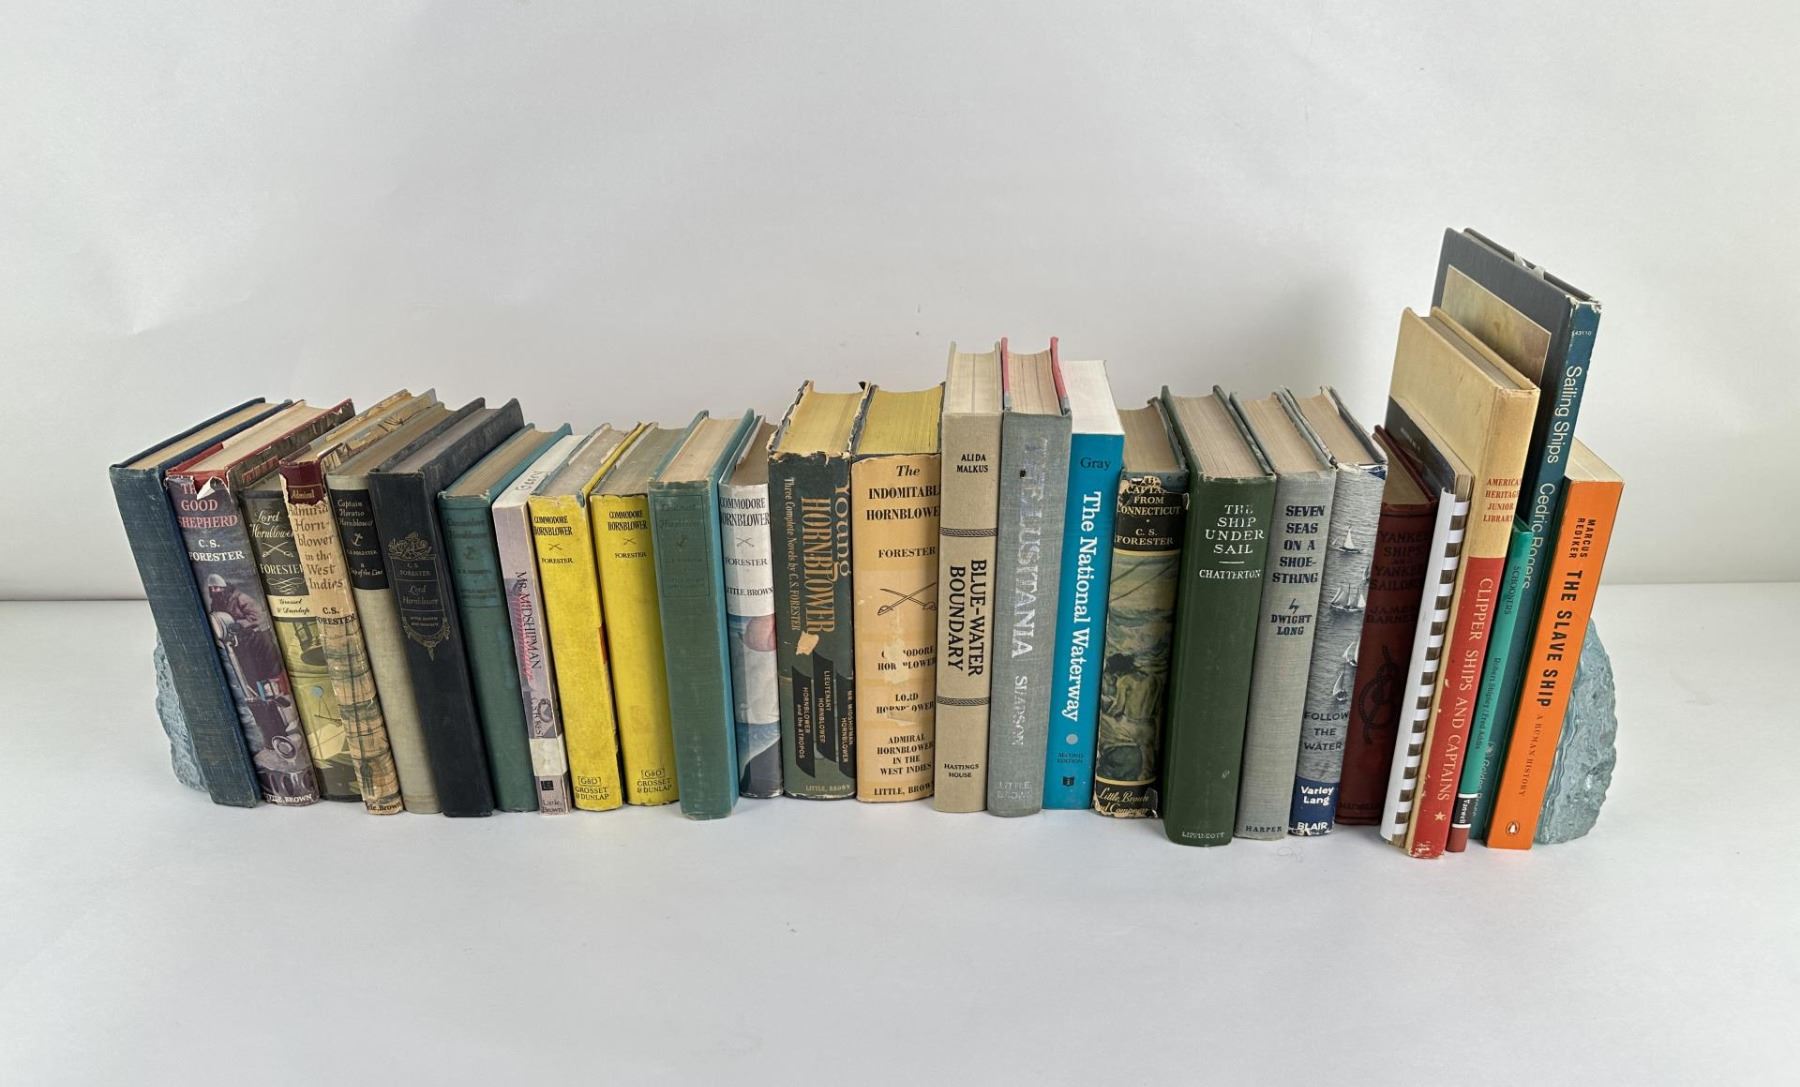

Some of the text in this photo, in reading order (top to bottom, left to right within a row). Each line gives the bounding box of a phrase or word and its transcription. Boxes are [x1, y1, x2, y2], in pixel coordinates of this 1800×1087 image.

[1554, 365, 1583, 418] Sailing
[1547, 421, 1571, 465] Ships
[960, 453, 987, 462] ALIDA
[1080, 457, 1112, 470] Gray
[895, 464, 921, 477] The
[956, 464, 989, 473] MALKUS
[783, 477, 795, 500] Three
[868, 485, 940, 499] INDOMITABL
[181, 499, 218, 512] GOOD
[720, 496, 766, 510] COMMODORE
[1134, 496, 1164, 504] FROM
[866, 506, 940, 520] HORNBLOWE
[1285, 505, 1326, 517] SEVEN
[1487, 503, 1514, 511] JUNIOR
[1531, 483, 1556, 533] Cedric
[257, 510, 280, 526] Lord
[534, 515, 568, 524] COMMODORE
[608, 510, 643, 519] COMMODORE
[784, 502, 797, 536] Complete
[295, 519, 331, 532] Horn-
[607, 521, 648, 531] HORNBLOWER
[1217, 517, 1257, 528] SHIP
[1286, 522, 1319, 534] SEAS
[249, 522, 293, 539] Hornblowe
[533, 526, 573, 536] HORNBLOWER
[832, 482, 852, 582] Young
[1205, 529, 1265, 541] UNDER
[298, 533, 335, 546] blower
[1115, 535, 1175, 546] FORESTER
[1569, 517, 1586, 559] REDIKER
[1579, 518, 1597, 558] MARCUS
[786, 537, 798, 561] Novels
[878, 546, 936, 558] FORESTER
[1213, 544, 1254, 555] SAIL
[1283, 540, 1316, 551] ON A
[304, 550, 331, 560] in the
[801, 496, 836, 634] HORNBLOWER
[1279, 556, 1317, 568] SHOE-
[306, 563, 337, 576] West
[1199, 569, 1262, 579] CHATTERTON
[308, 578, 344, 590] Indies
[1011, 508, 1042, 658] LUSITANIA
[1271, 572, 1319, 584] STRING
[1504, 565, 1521, 616] SCHOONERS
[789, 590, 801, 631] FORESTER
[1061, 491, 1102, 722] The National Waterway
[1288, 598, 1300, 614] by
[947, 565, 966, 671] BOUNDARY
[967, 559, 987, 676] BLUE-WATER
[1270, 614, 1313, 624] DWIGHT
[519, 592, 542, 669] MIDSHIPMAN
[1276, 625, 1305, 636] LONG
[1537, 570, 1583, 707] THE SLAVE SHIP
[1437, 577, 1494, 801] CLIPPER SHIPS AND CAPTAINS
[802, 687, 810, 734] HORNBLOWER
[1304, 711, 1349, 721] FOLLOW
[818, 697, 826, 743] HORNBLOWER
[1313, 727, 1337, 736] THE
[841, 717, 849, 763] HORNBLOWER
[889, 733, 926, 745] ADMIRAL
[1529, 723, 1542, 757] HUMAN
[876, 742, 935, 755] HORNBLOWER
[1303, 742, 1343, 751] WATER
[892, 756, 921, 764] IN THE
[880, 763, 932, 776] WEST INDIES
[637, 779, 671, 787] GROSSET
[1519, 760, 1534, 796] HISTORY
[575, 786, 608, 794] GROSSET
[643, 785, 672, 793] DUNLAP
[873, 782, 933, 796] LITTLE, BROW
[1301, 785, 1335, 795] Varley
[581, 793, 610, 801] DUNLAP
[1303, 796, 1330, 806] Lang
[1245, 825, 1283, 833] HARPER
[1297, 822, 1329, 831] BLAIR
